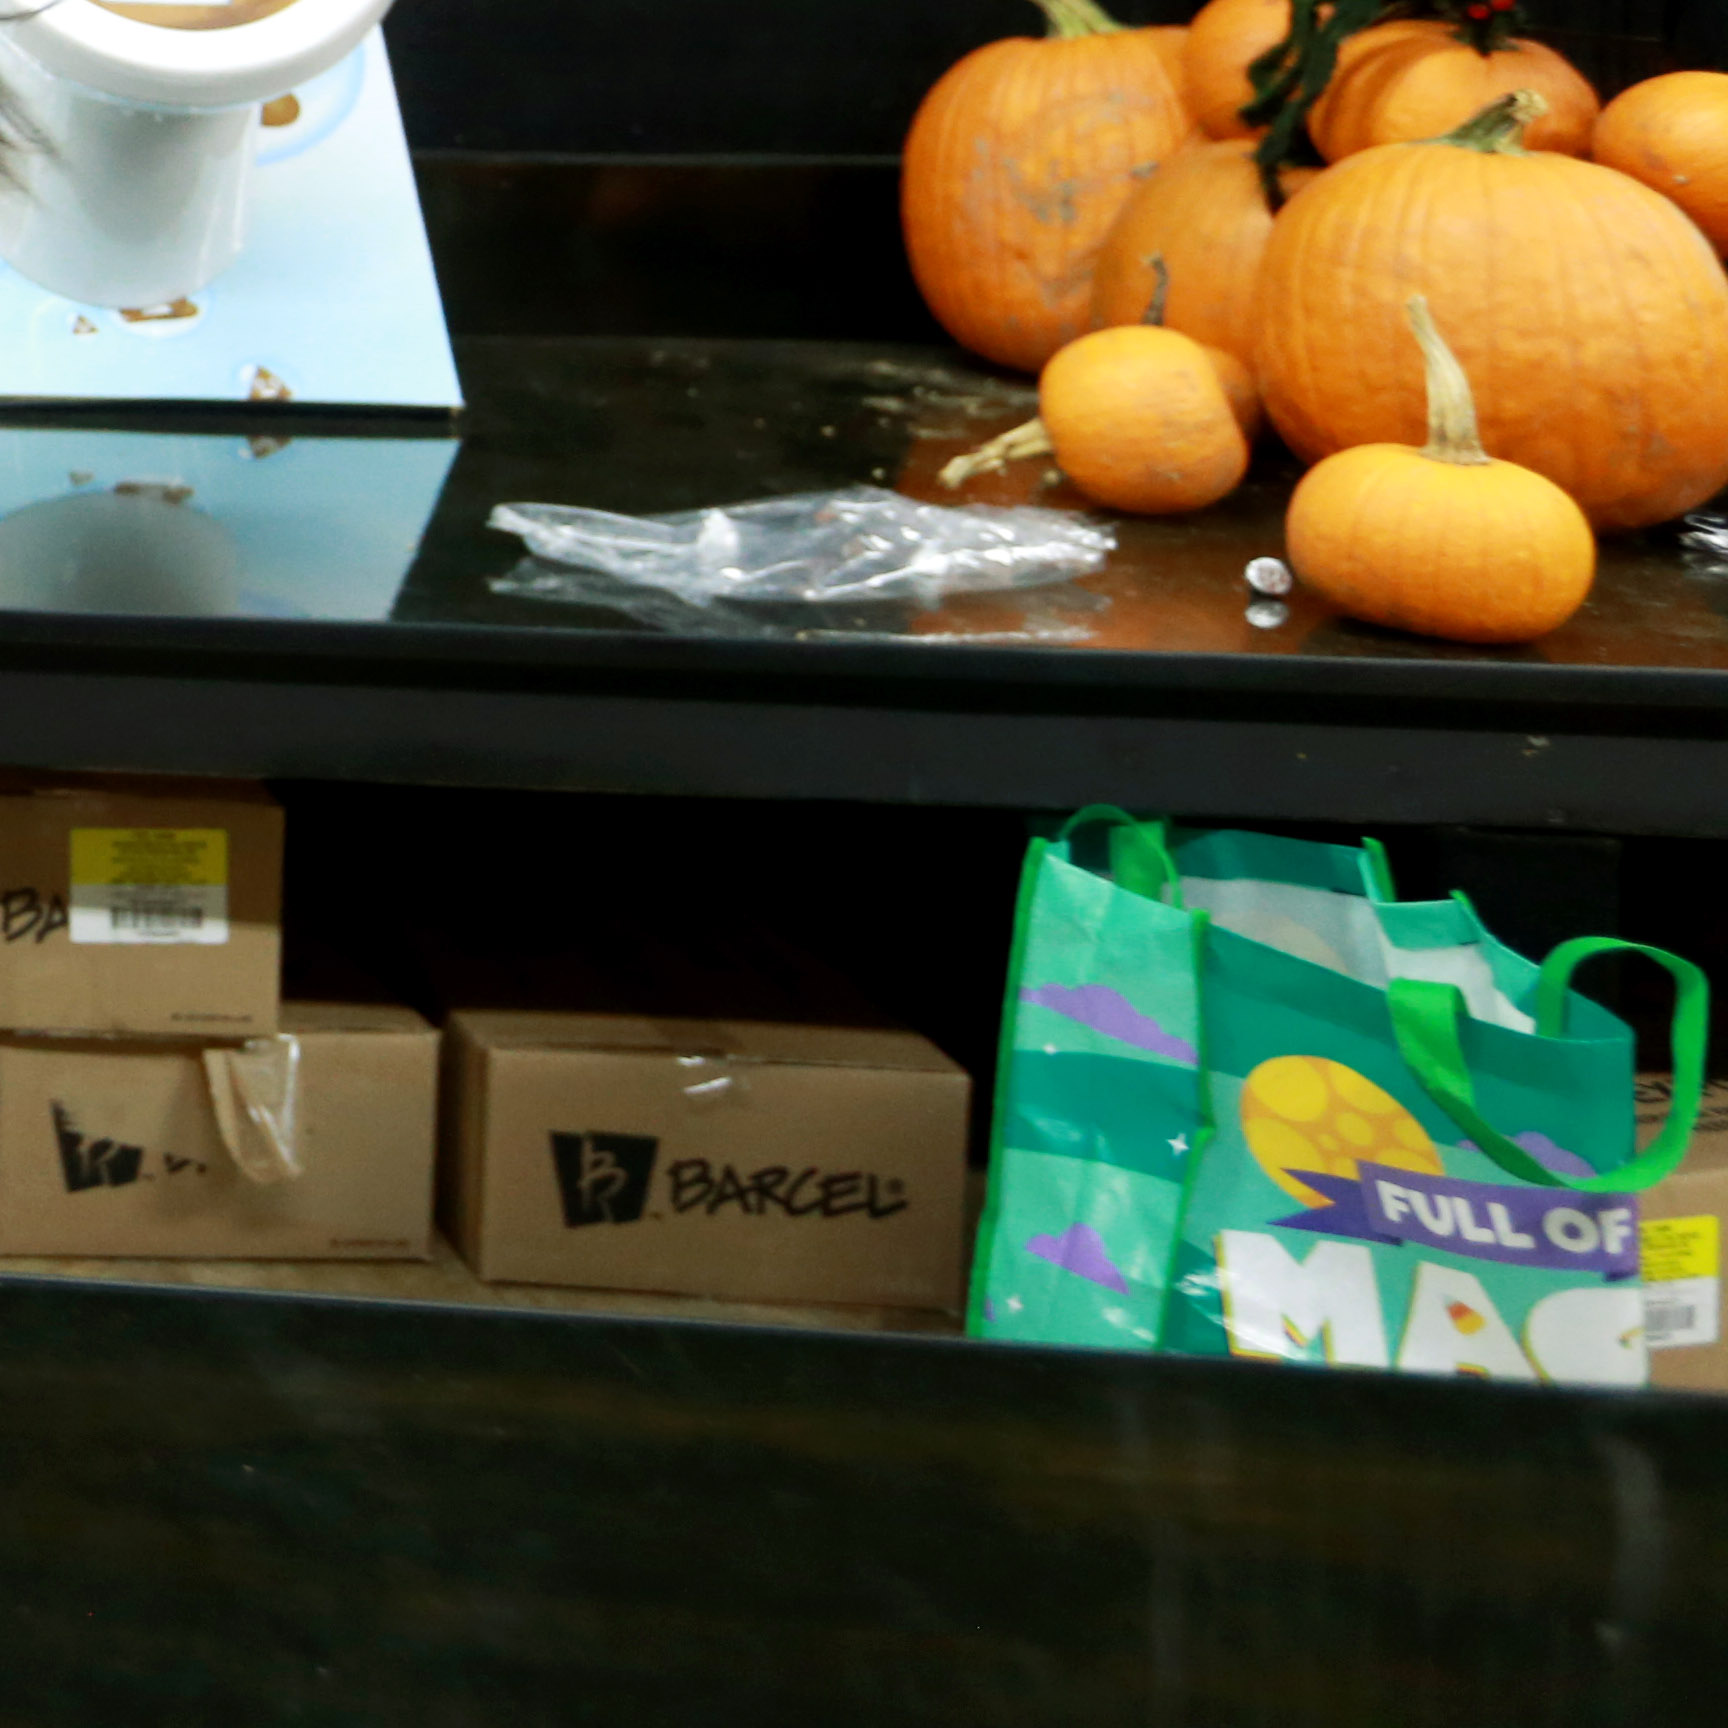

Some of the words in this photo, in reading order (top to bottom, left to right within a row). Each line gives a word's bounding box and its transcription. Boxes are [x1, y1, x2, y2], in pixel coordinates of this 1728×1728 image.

[668, 1157, 908, 1220] BARCEL
[1374, 1179, 1536, 1250] FULL
[1543, 1206, 1633, 1256] OF
